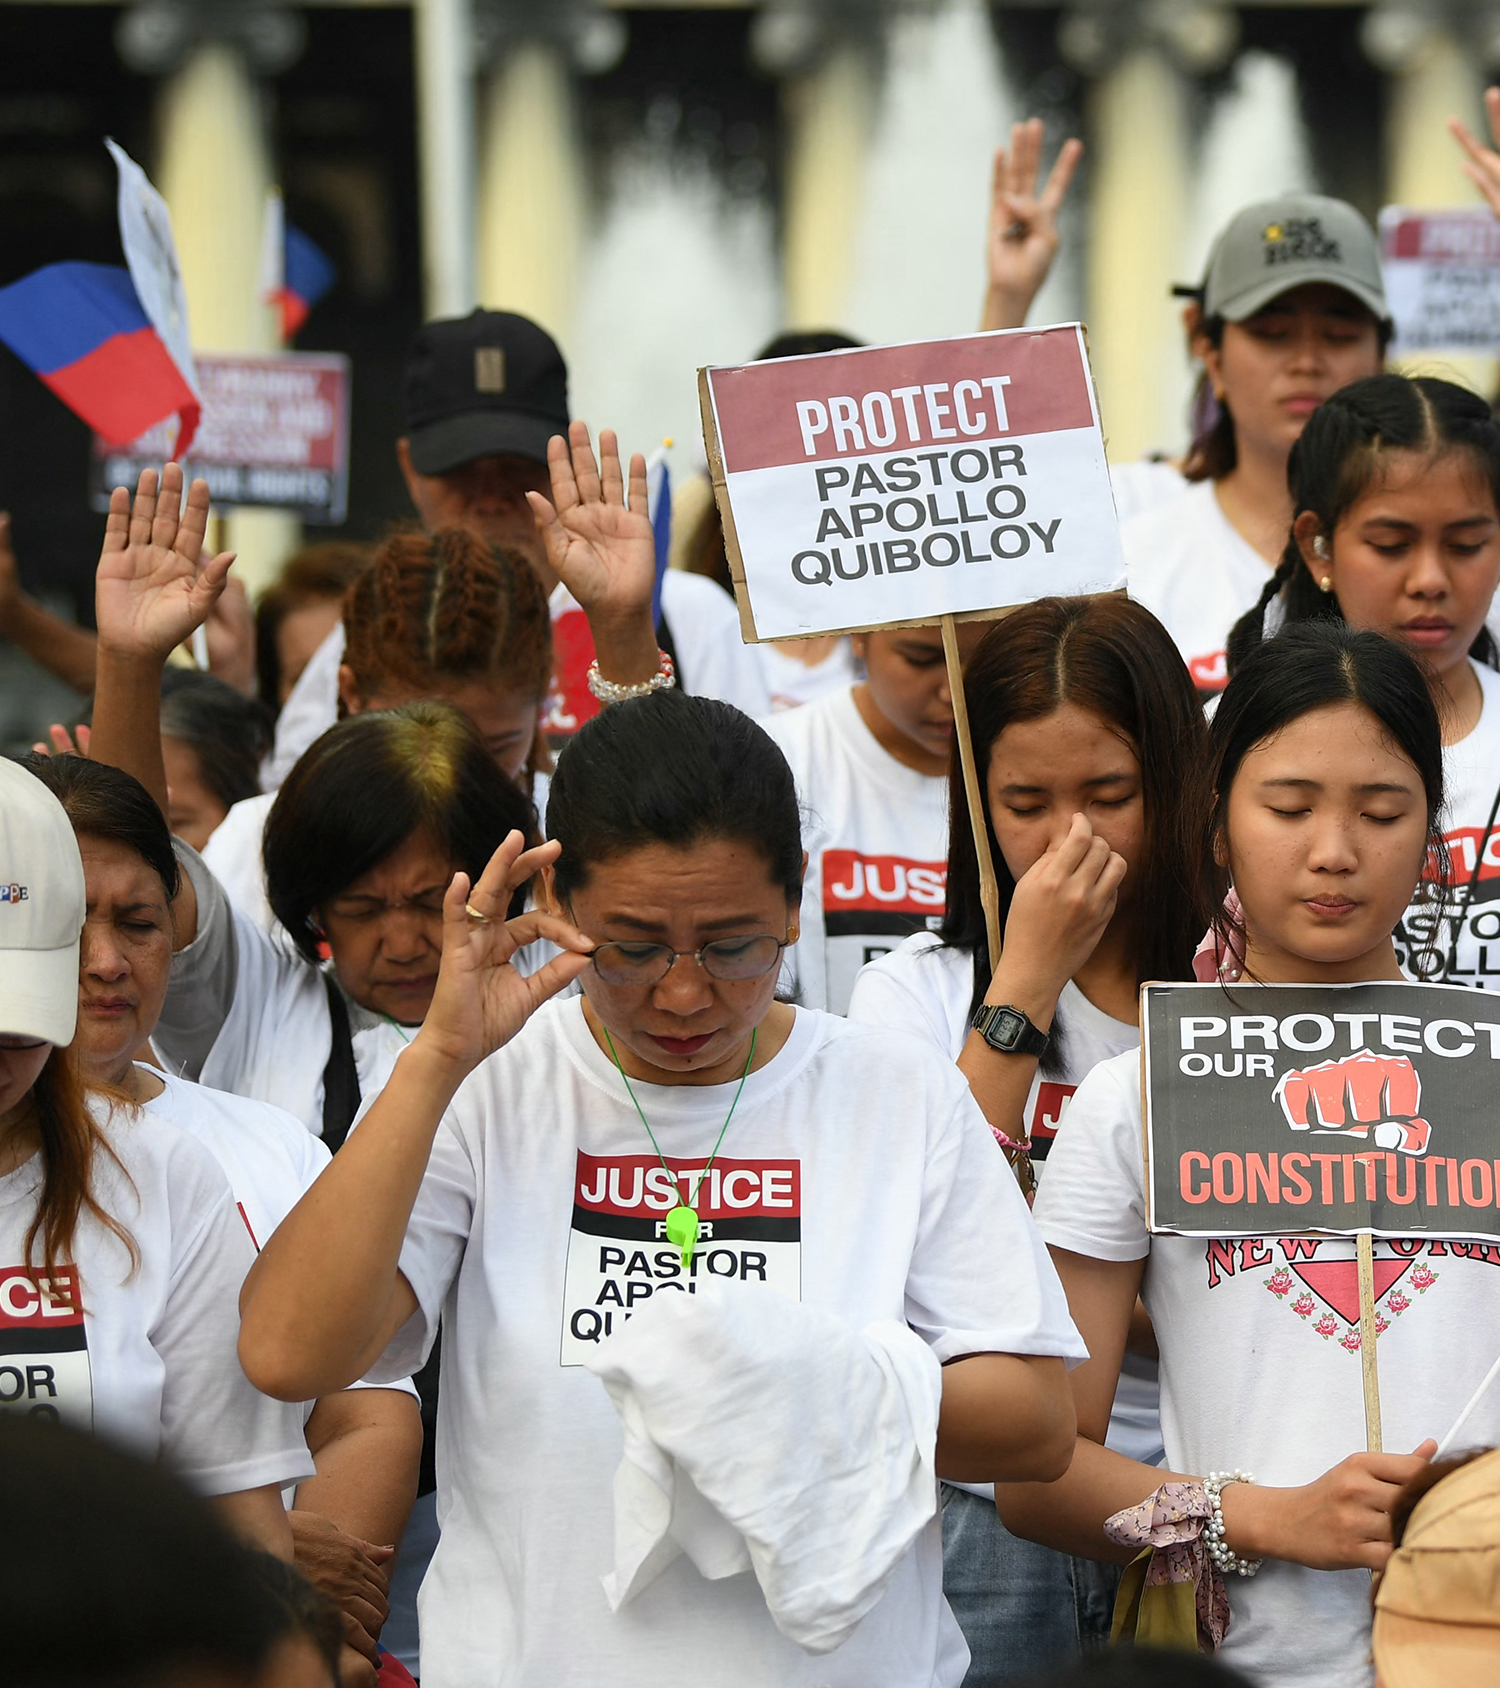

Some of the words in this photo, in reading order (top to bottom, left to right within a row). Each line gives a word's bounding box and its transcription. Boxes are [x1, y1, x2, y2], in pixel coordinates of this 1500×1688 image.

[795, 375, 1012, 456] PROTECT
[815, 444, 1028, 501] PASTOR
[815, 484, 1028, 543] APOLLO
[791, 518, 1063, 586] QUIBOLOY
[1179, 1053, 1275, 1078] OUR
[580, 1167, 794, 1210] JUSTICE
[599, 1246, 767, 1281] PASTOR
